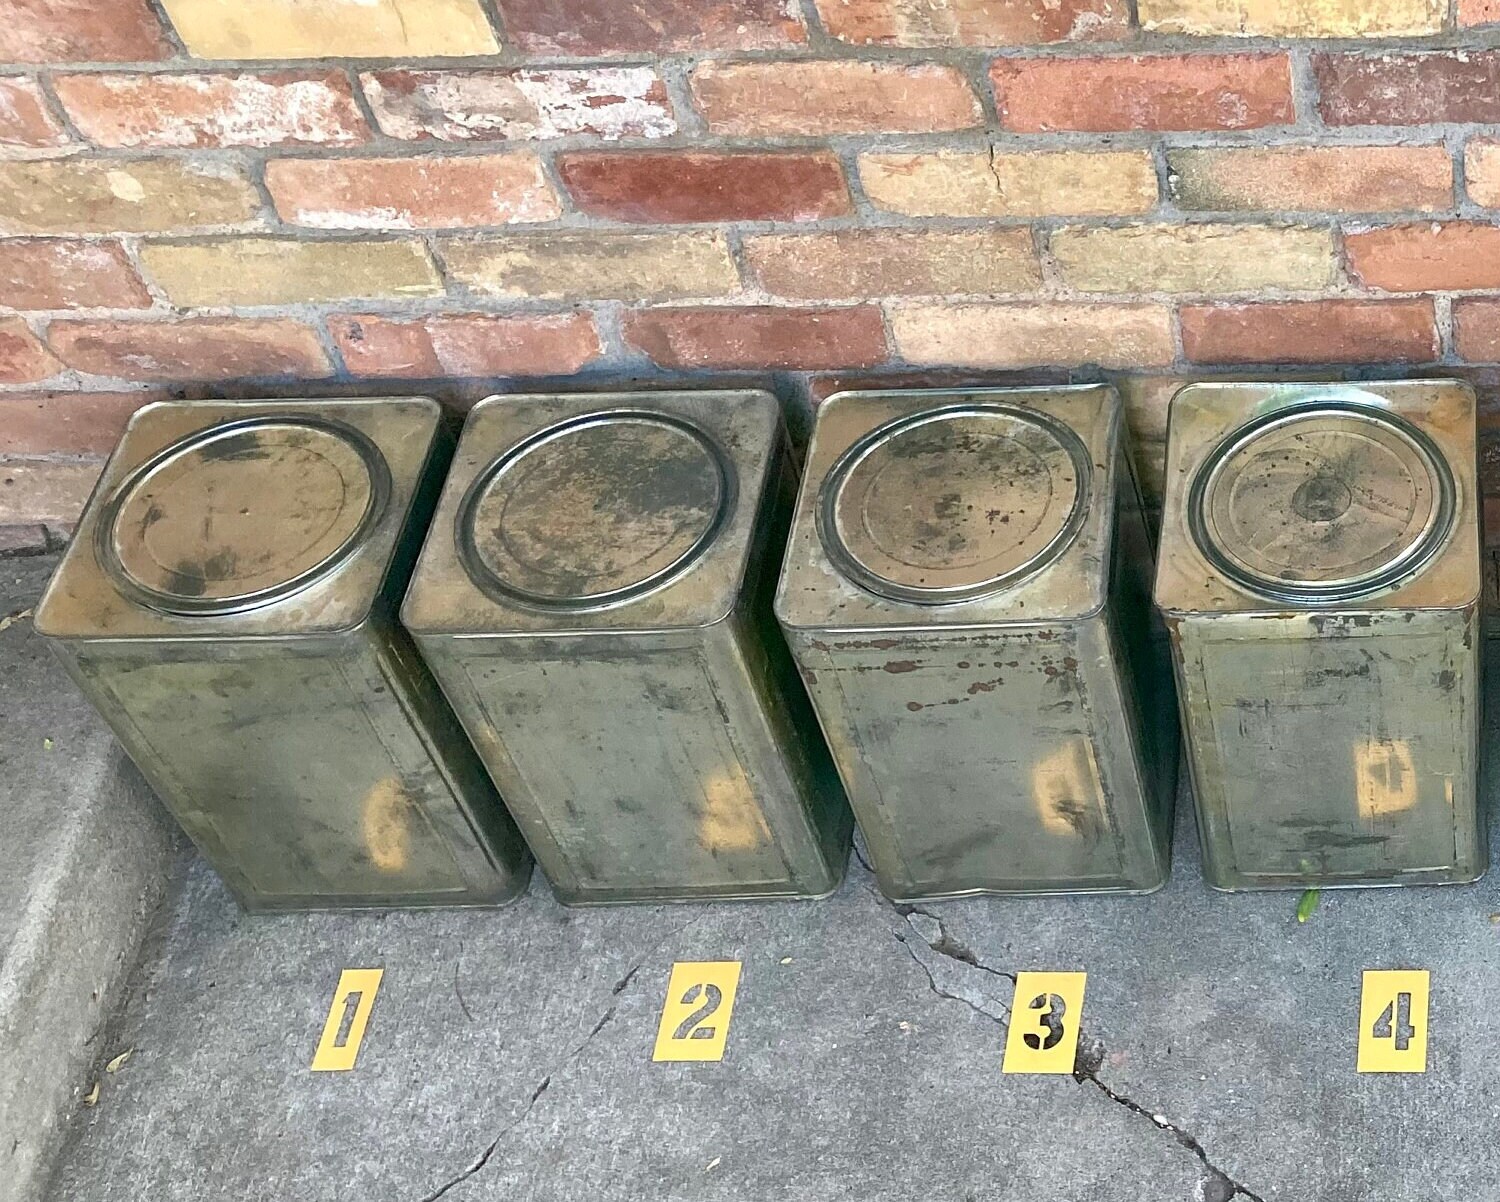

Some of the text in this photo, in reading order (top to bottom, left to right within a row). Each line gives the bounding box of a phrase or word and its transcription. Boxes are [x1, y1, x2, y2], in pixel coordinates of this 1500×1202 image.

[333, 991, 363, 1047] 1
[673, 983, 723, 1039] 2
[1022, 992, 1067, 1050] 3
[1372, 992, 1415, 1050] 4
